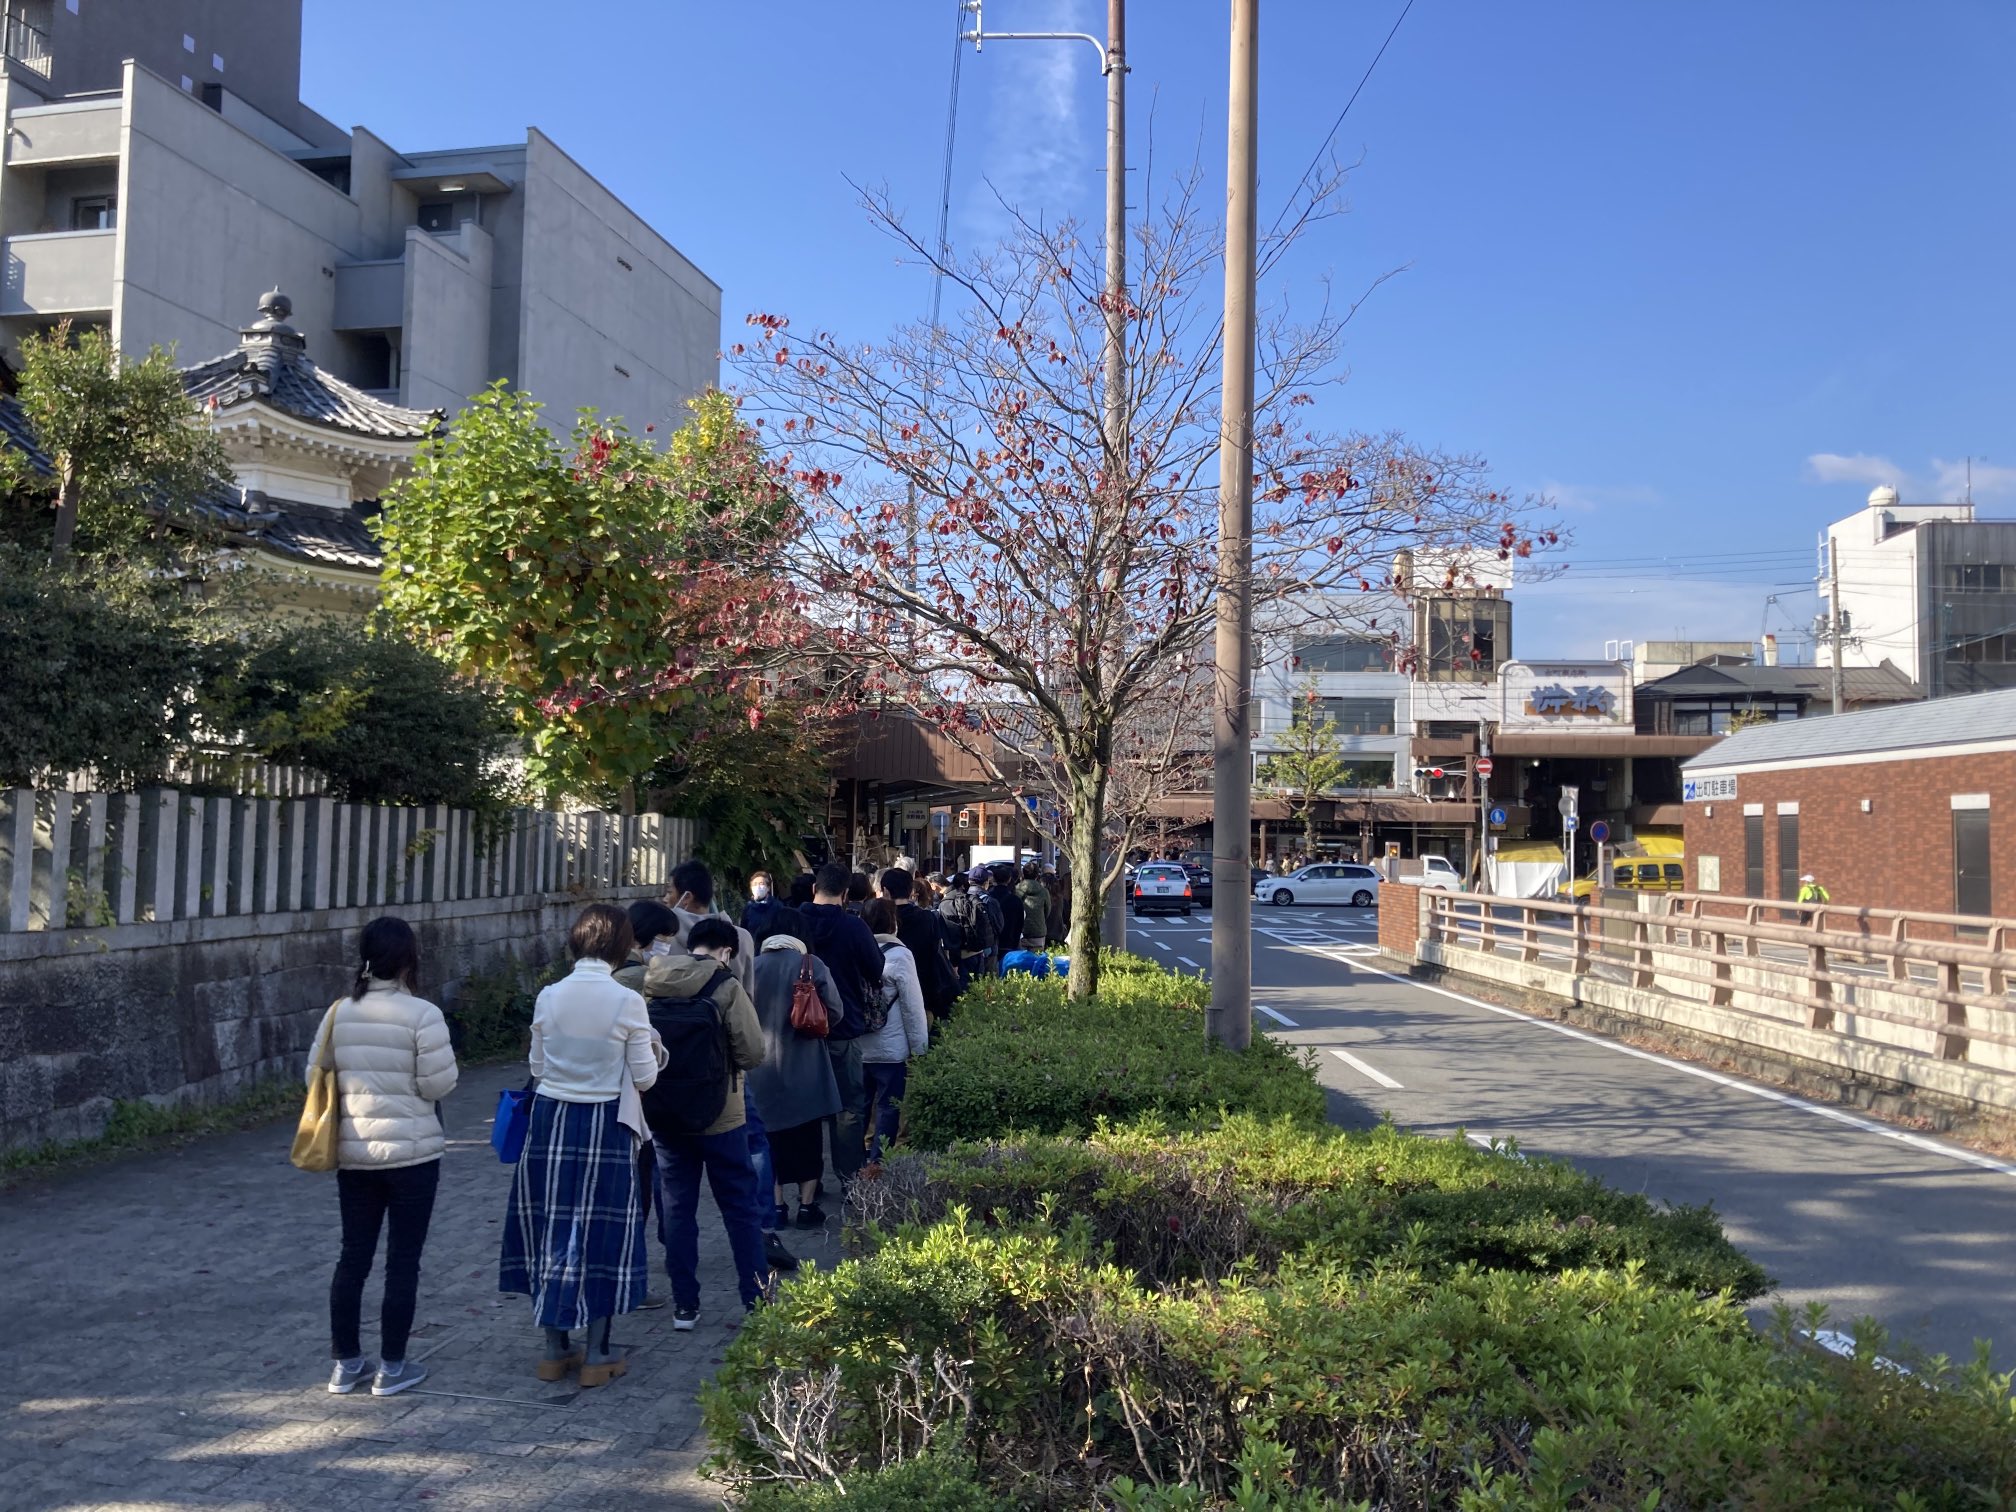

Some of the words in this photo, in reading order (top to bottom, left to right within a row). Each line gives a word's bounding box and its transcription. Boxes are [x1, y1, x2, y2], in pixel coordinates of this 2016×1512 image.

[1696, 779, 1736, 798] 出町駐車場
